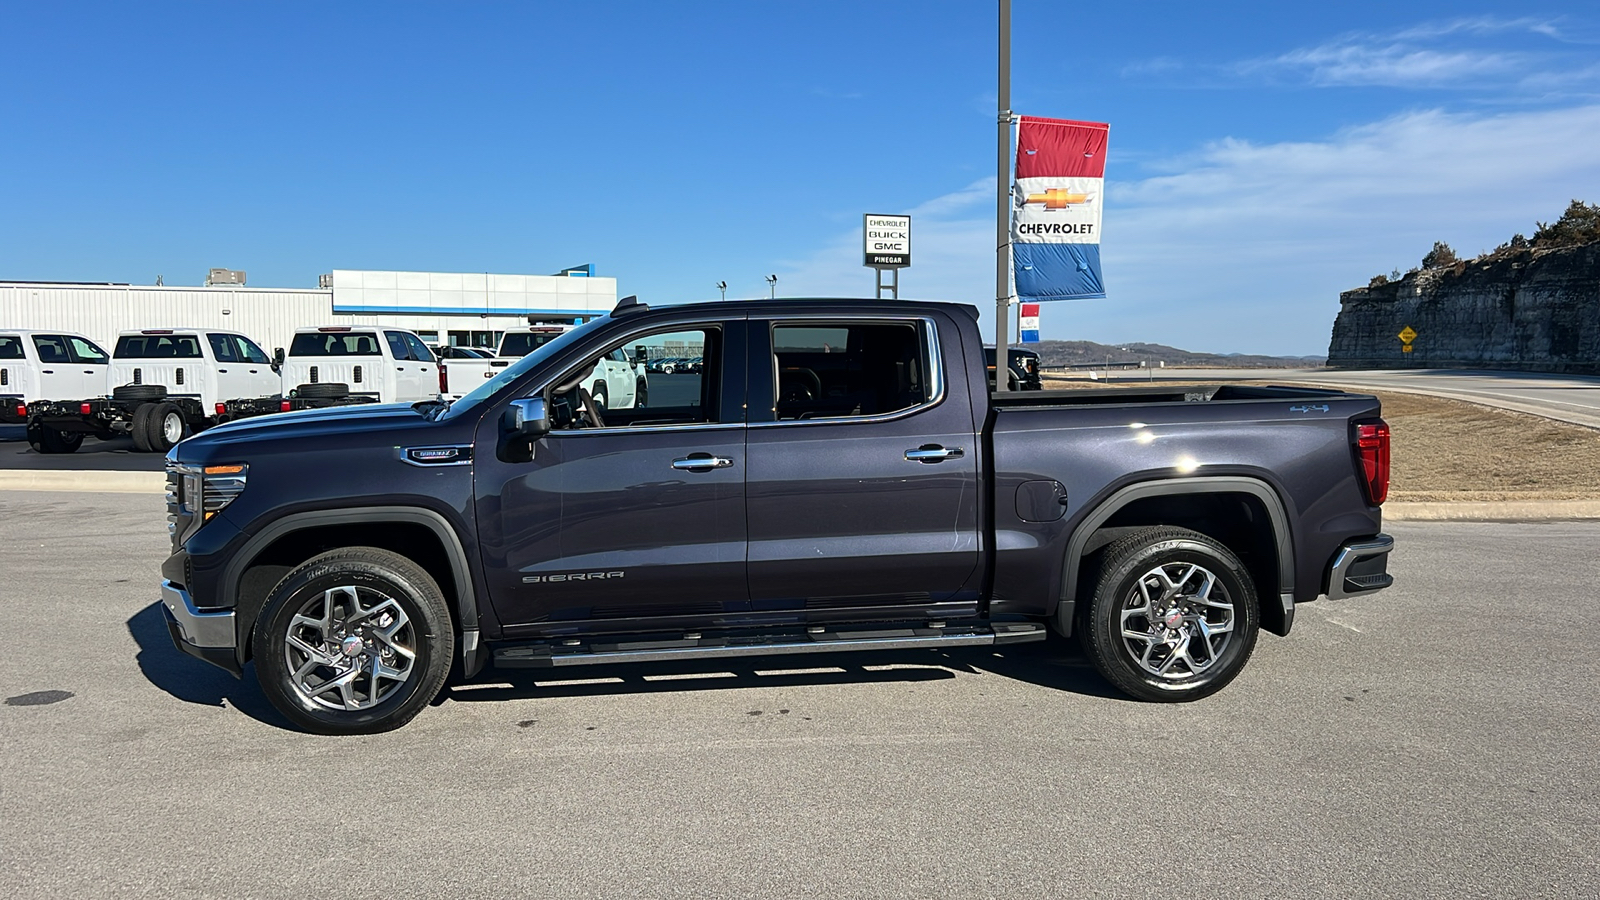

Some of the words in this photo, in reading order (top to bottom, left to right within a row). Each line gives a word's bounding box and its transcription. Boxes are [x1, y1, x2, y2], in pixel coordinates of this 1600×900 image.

[870, 219, 907, 228] CHEVROLET
[1019, 223, 1093, 234] CHEVROLET
[869, 231, 907, 239] BUICK
[874, 256, 902, 264] PINEGAR
[522, 571, 625, 584] SIERRA
